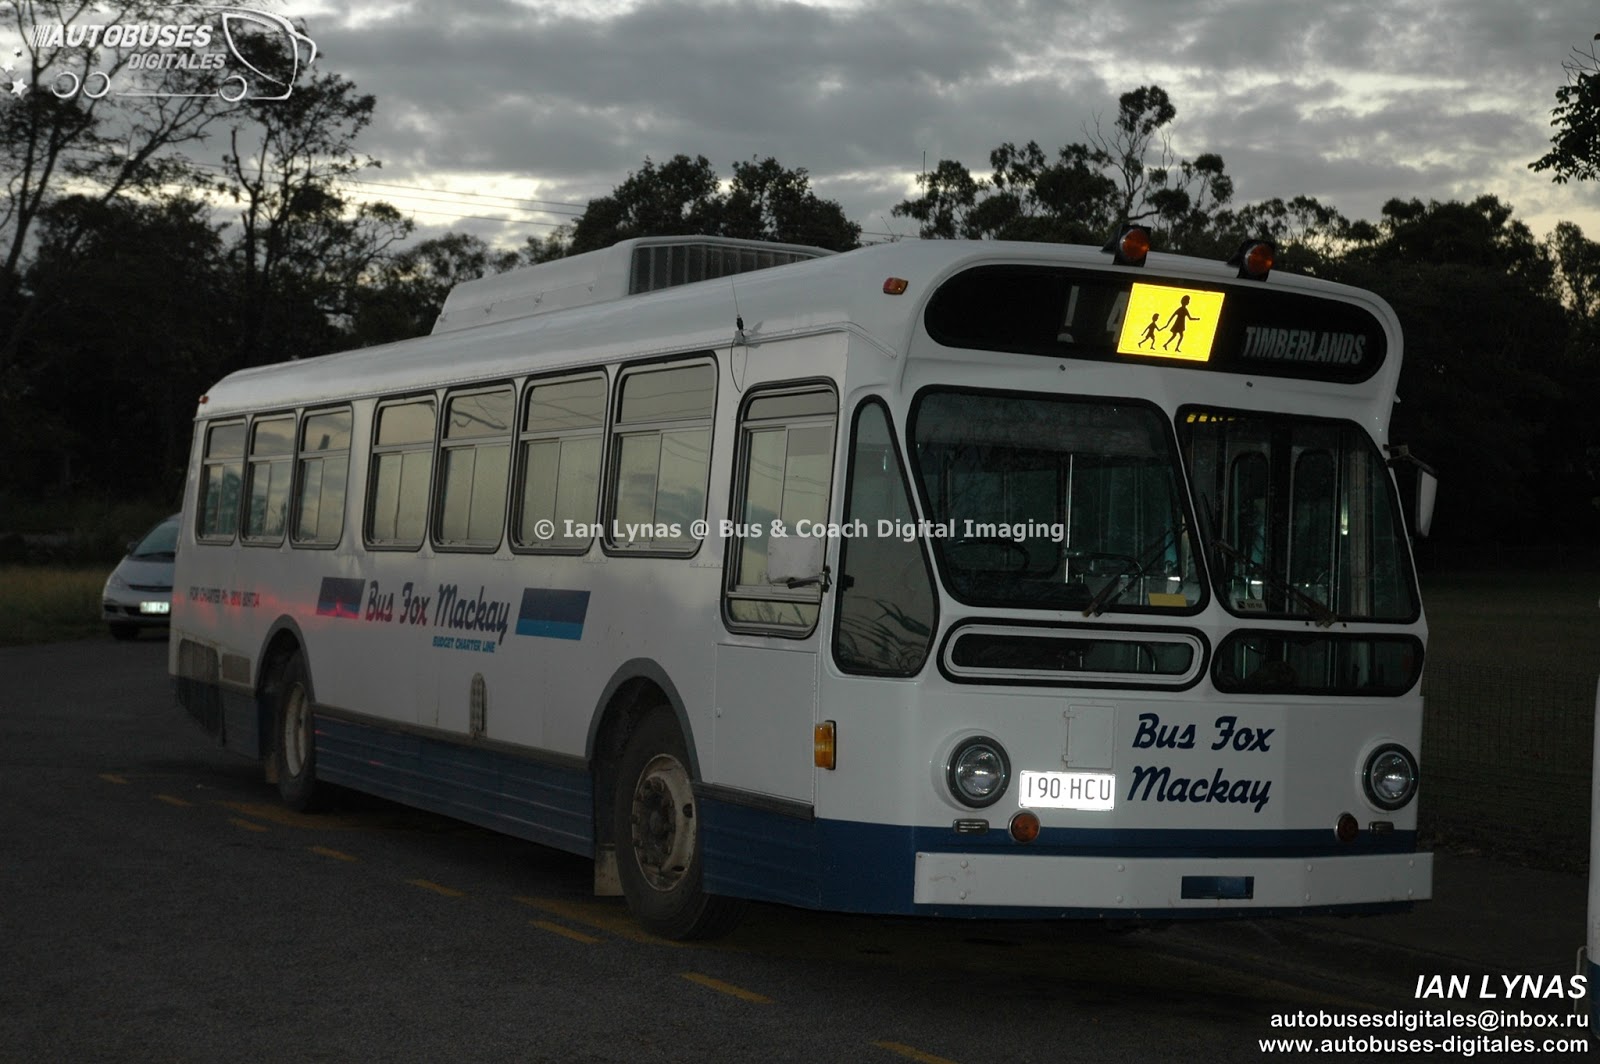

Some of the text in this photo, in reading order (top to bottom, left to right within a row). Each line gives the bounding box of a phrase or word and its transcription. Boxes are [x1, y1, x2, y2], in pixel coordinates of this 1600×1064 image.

[1243, 326, 1366, 365] TIMBERLANDS
[365, 580, 511, 646] Bus Fox Mackay
[432, 635, 496, 653] BUDGET CHARTER LINE
[1132, 713, 1276, 752] Bus Fox
[1127, 765, 1272, 814] Mackay
